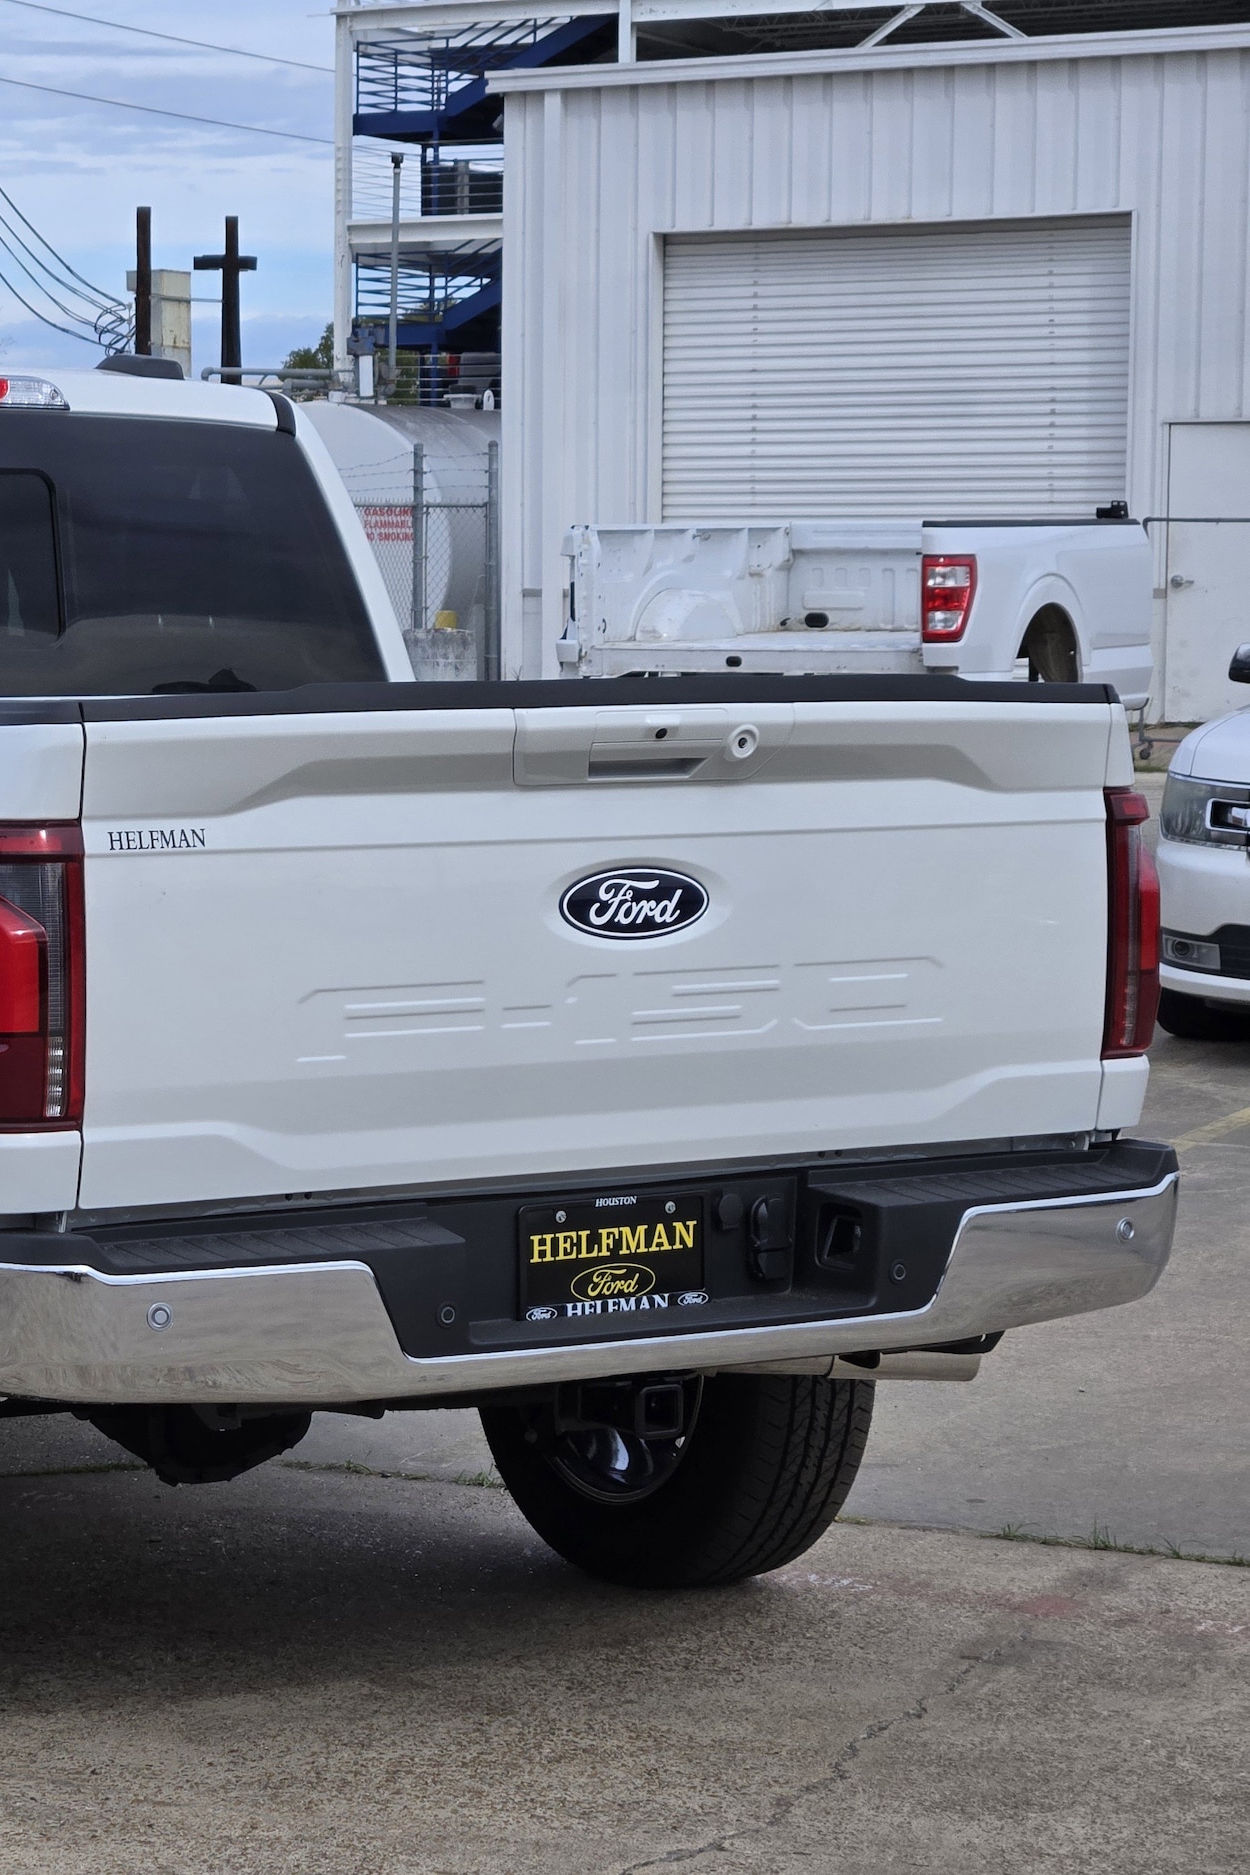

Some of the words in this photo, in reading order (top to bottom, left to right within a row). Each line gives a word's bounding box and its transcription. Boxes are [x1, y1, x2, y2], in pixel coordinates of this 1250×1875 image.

[107, 828, 206, 851] HELFMAN
[588, 878, 684, 926] Ford
[595, 1195, 637, 1208] HOUSTON
[529, 1220, 698, 1264] HELFMAN
[587, 1267, 640, 1297] Ford
[531, 1308, 552, 1321] Ford
[683, 1293, 704, 1305] Ford
